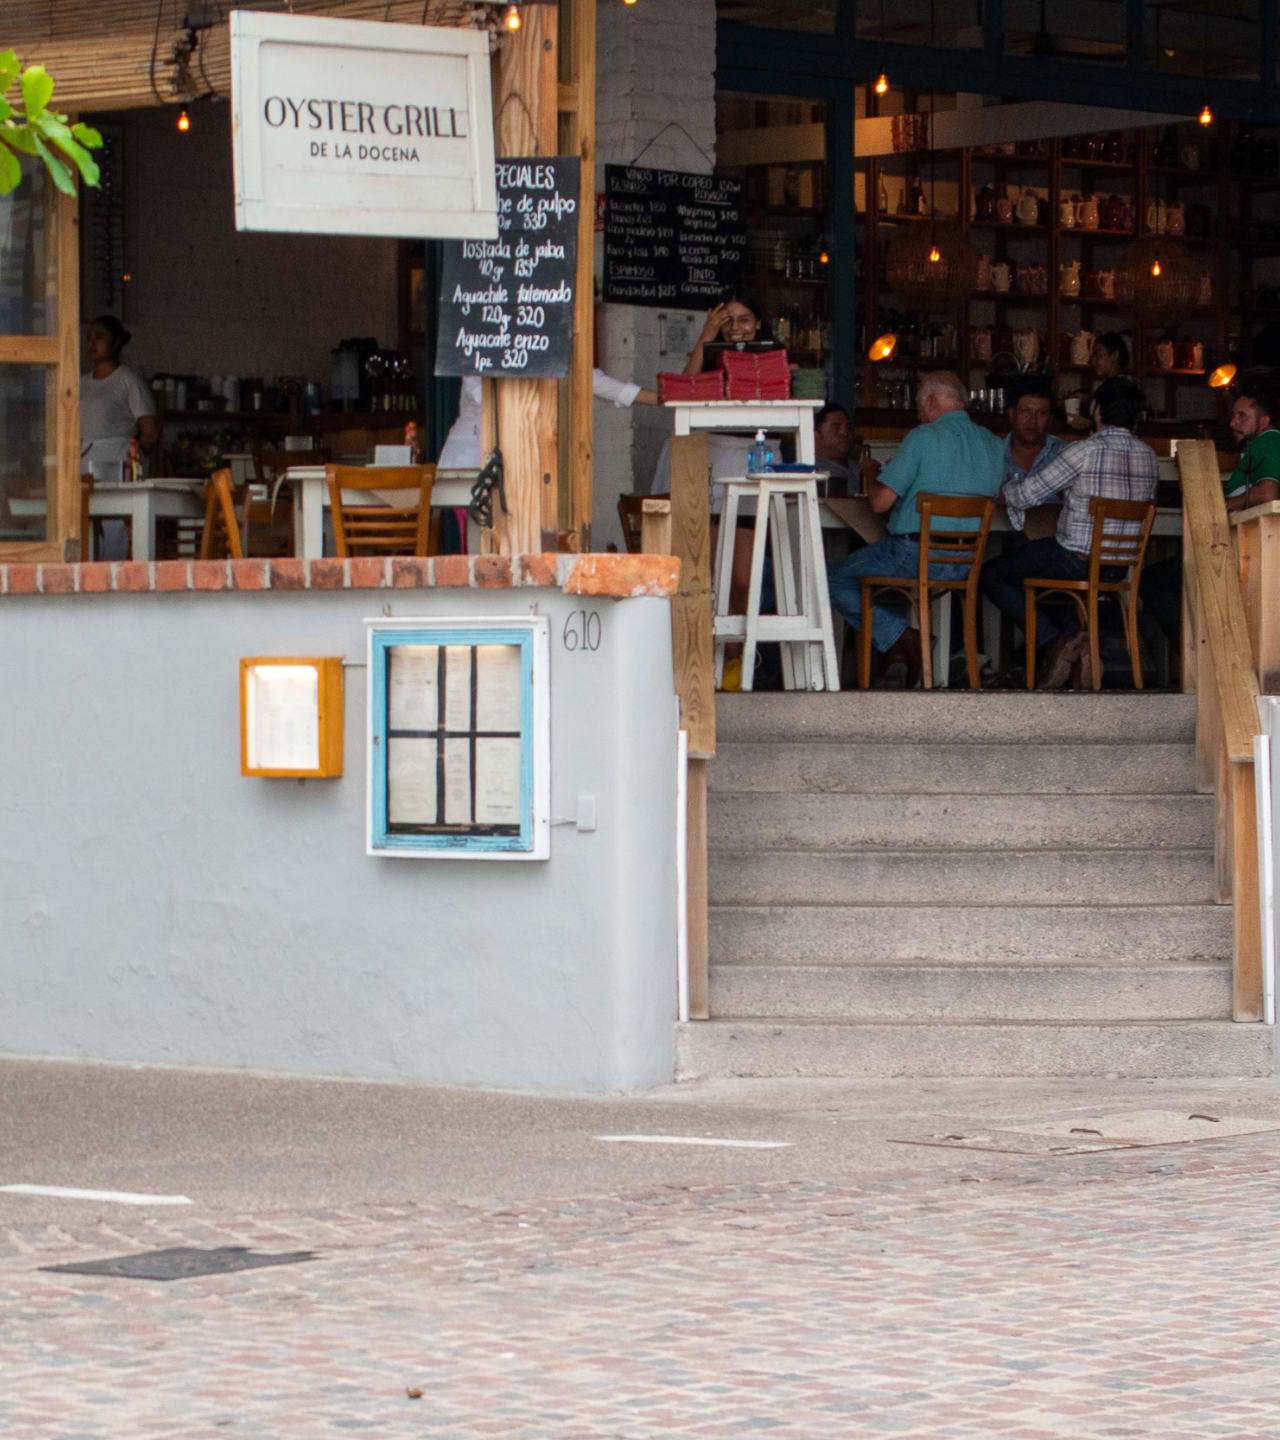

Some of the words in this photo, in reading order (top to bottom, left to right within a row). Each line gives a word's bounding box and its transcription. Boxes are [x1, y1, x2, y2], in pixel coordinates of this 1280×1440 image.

[263, 96, 377, 135] OYSTER
[383, 104, 468, 139] GRILL
[309, 141, 328, 158] DE
[334, 143, 353, 160] LA
[358, 144, 421, 163] DOCENA
[496, 163, 556, 190] PECIALES
[516, 193, 535, 214] de
[537, 190, 577, 223] pulpo
[515, 237, 530, 259] de
[452, 283, 509, 316] Aguachile
[516, 305, 545, 329] 320
[501, 348, 529, 369] 320
[562, 609, 602, 652] 610
